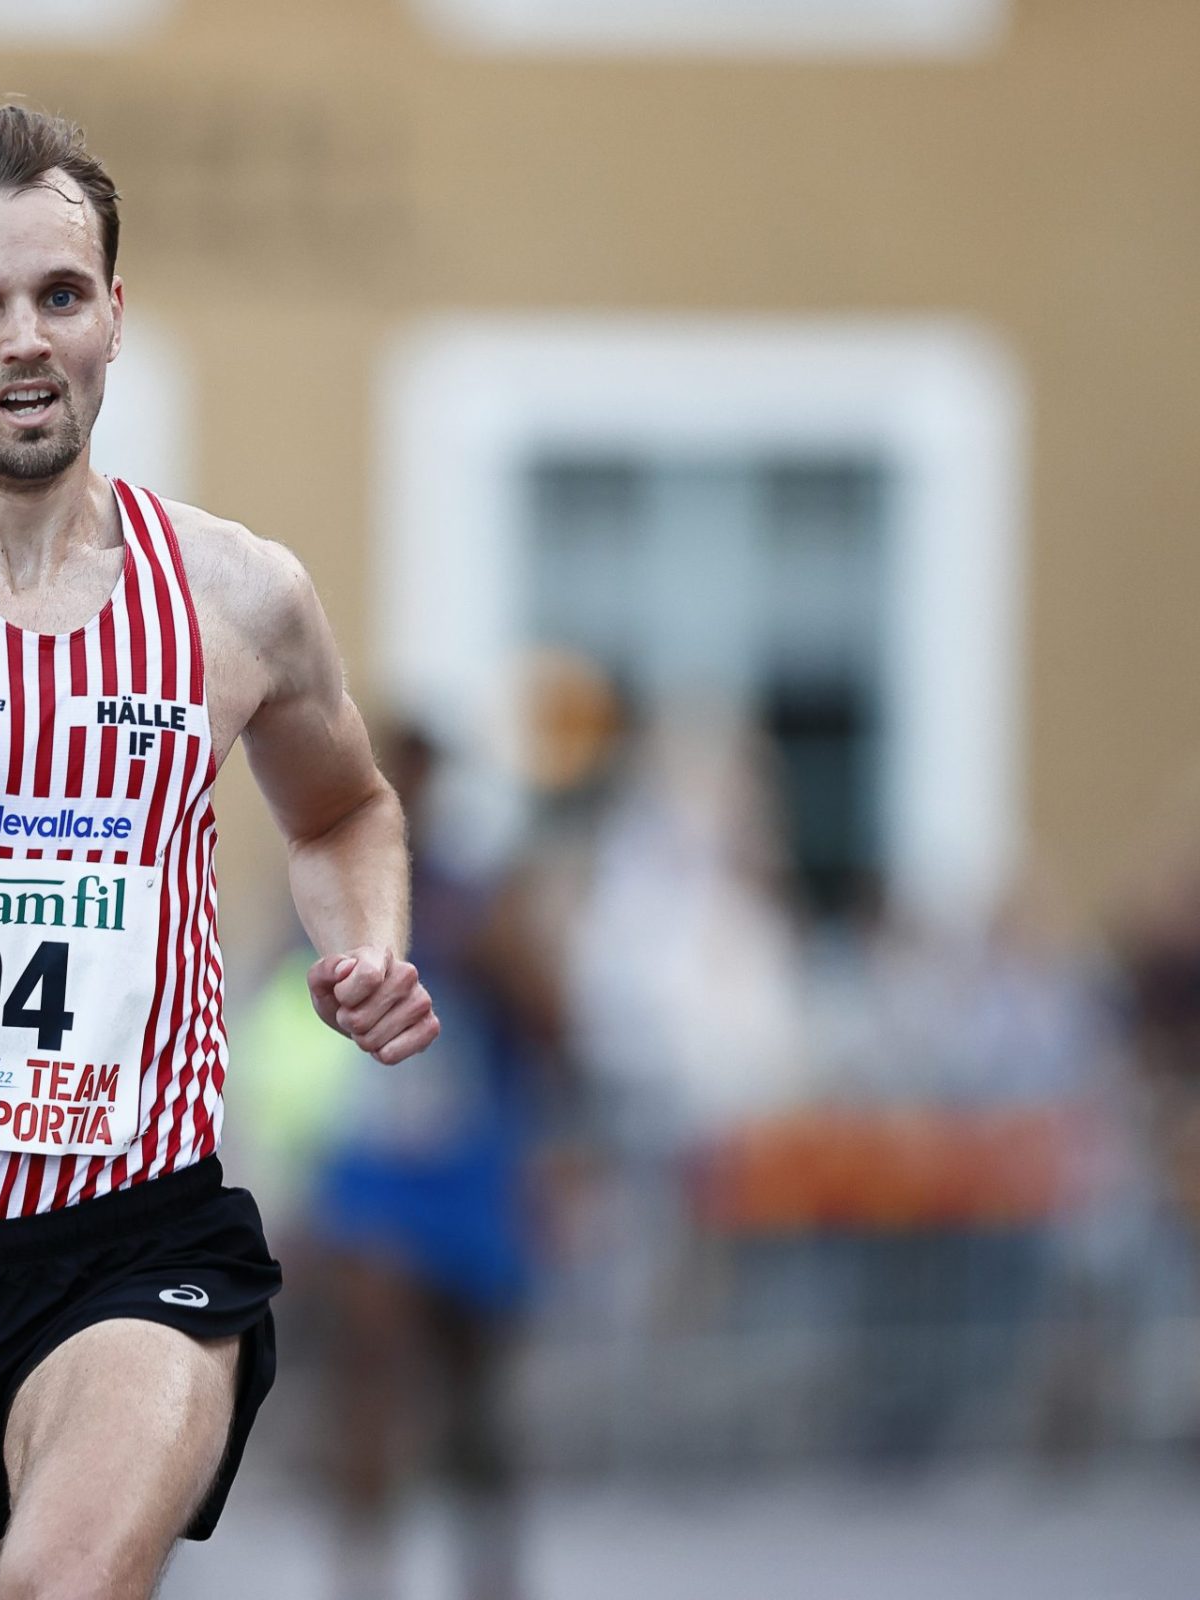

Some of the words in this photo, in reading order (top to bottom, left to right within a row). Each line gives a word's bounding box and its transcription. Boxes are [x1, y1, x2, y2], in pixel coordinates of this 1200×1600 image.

[97, 696, 186, 731] HÄLLE
[128, 731, 155, 756] IF
[26, 1059, 120, 1102] TEAM
